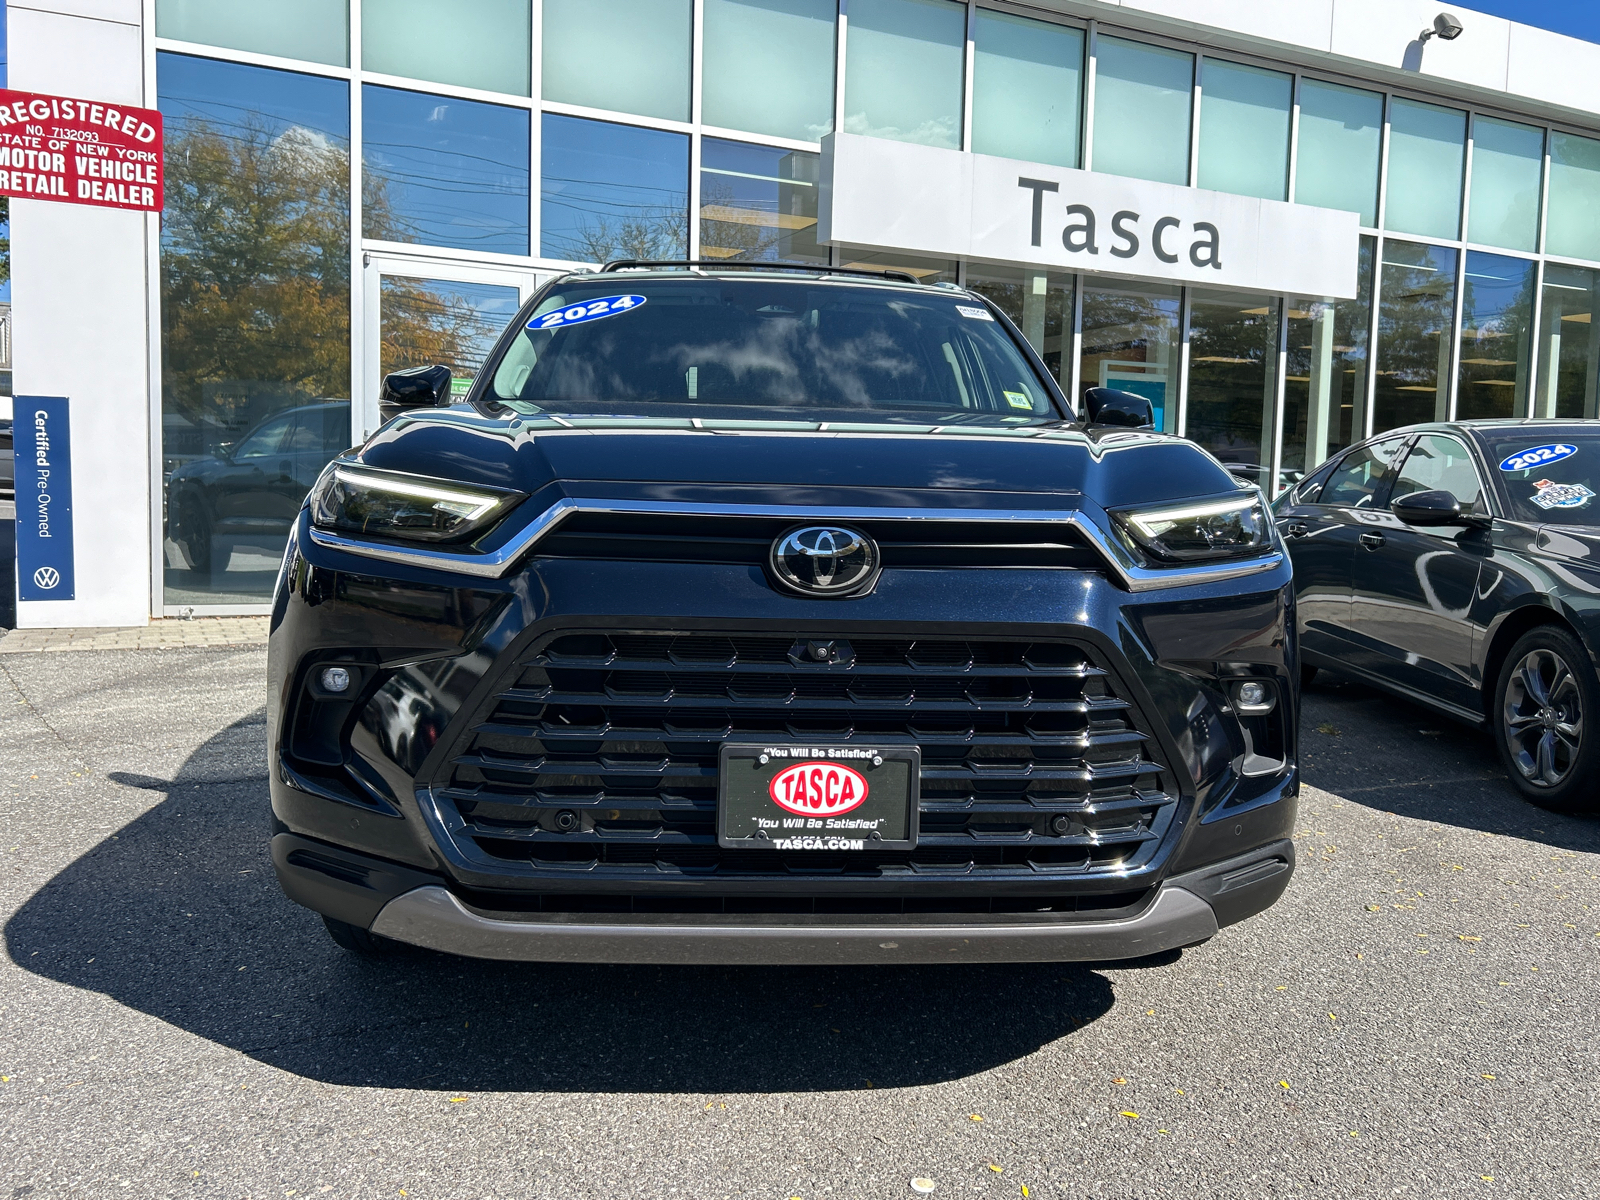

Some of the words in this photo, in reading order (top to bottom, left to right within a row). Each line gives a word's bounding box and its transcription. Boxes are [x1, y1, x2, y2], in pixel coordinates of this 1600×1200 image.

[0, 100, 156, 143] REGISTERED
[26, 124, 45, 137] NO.
[52, 127, 99, 142] 7132093
[0, 133, 42, 148] TATE
[48, 139, 69, 151] OF
[76, 143, 109, 157] NEW
[115, 148, 158, 163] YORK
[0, 146, 66, 173] MOTOR
[75, 156, 157, 184] VEHICLE
[0, 170, 69, 196] RETAIL
[77, 179, 154, 206] DEALER
[1018, 176, 1222, 270] Tasca
[541, 296, 635, 328] 2024
[35, 410, 50, 466] Certified
[1508, 444, 1571, 470] 2024
[37, 469, 52, 538] Pre-Owned
[790, 748, 809, 758] Will
[811, 748, 826, 758] Be
[782, 768, 855, 809] TASCA
[783, 818, 804, 828] Will
[806, 819, 823, 829] Be
[773, 839, 864, 850] TASCA.COM
